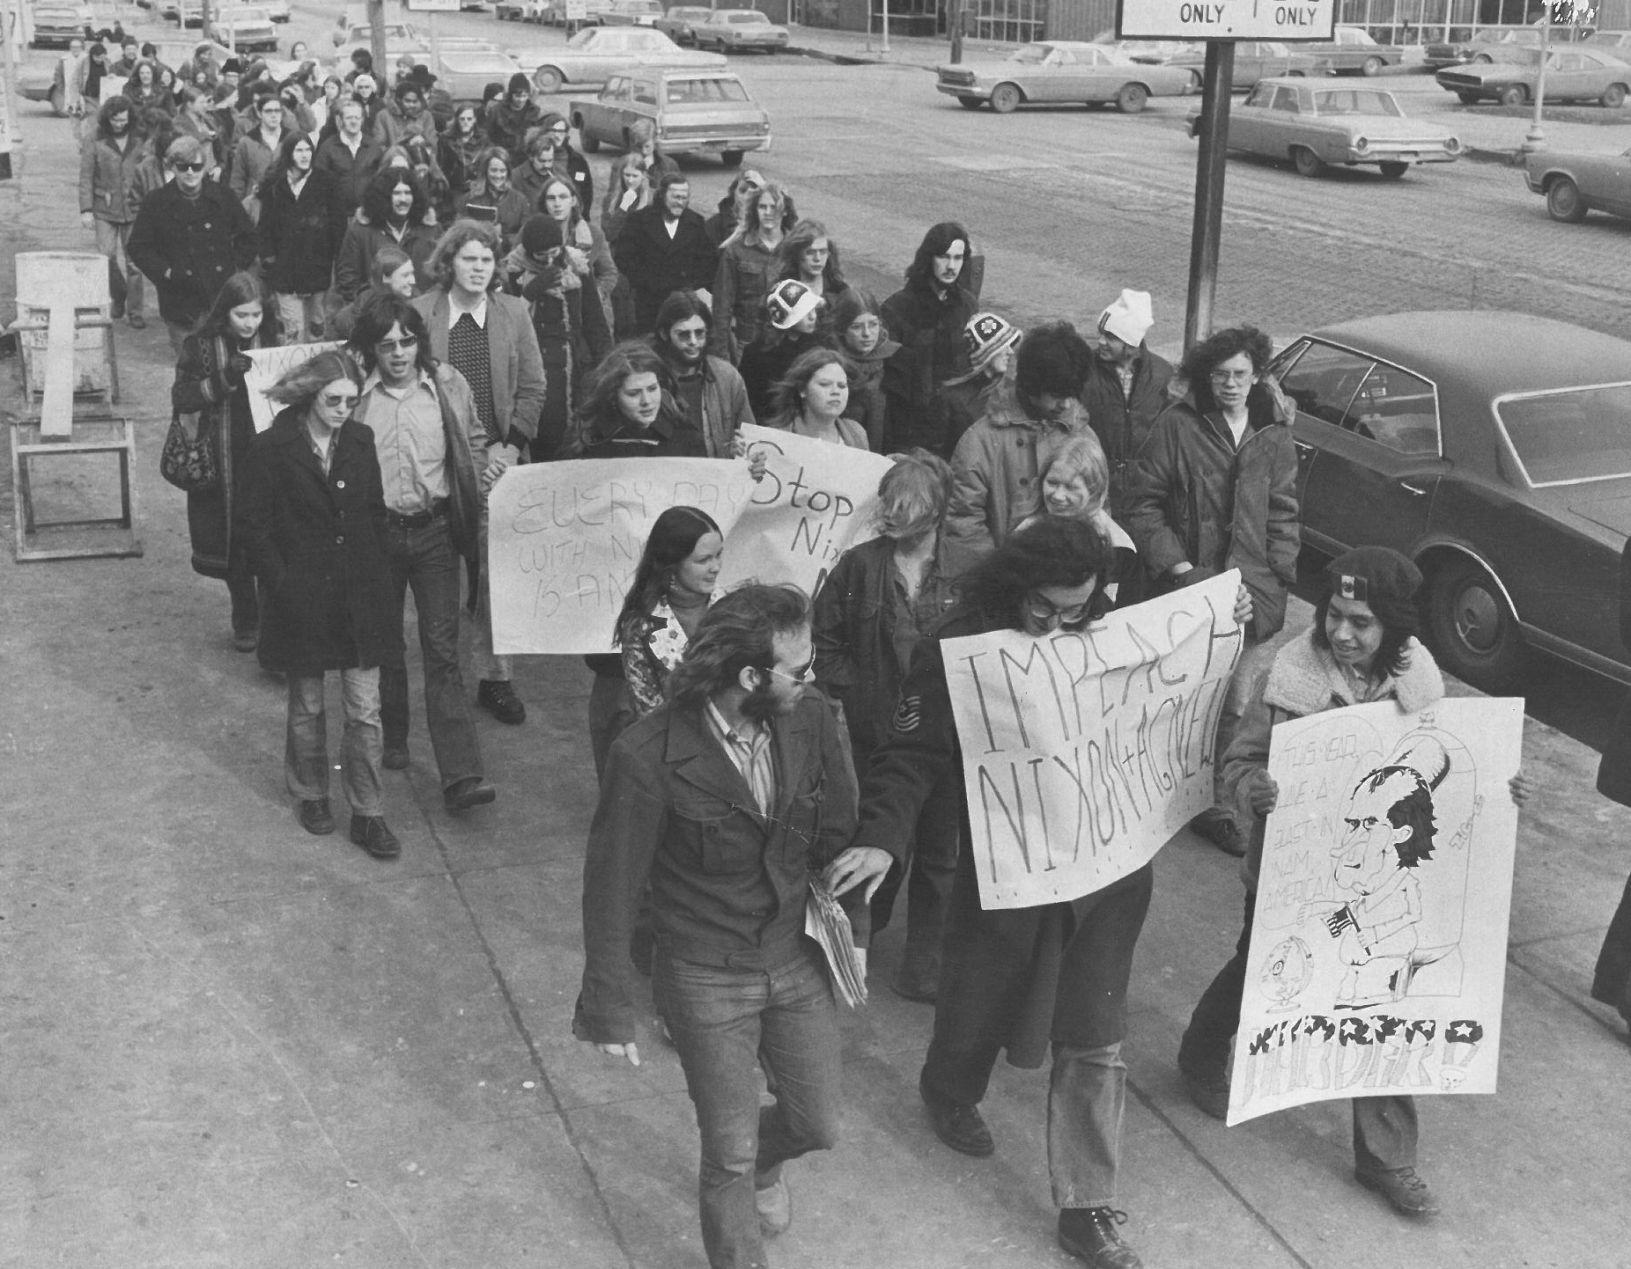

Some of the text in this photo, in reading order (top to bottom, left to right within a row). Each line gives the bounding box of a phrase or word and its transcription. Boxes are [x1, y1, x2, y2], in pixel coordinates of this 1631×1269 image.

[1180, 3, 1225, 24] ONLY
[1275, 6, 1317, 26] ONLY
[959, 595, 1242, 754] IMPEACH
